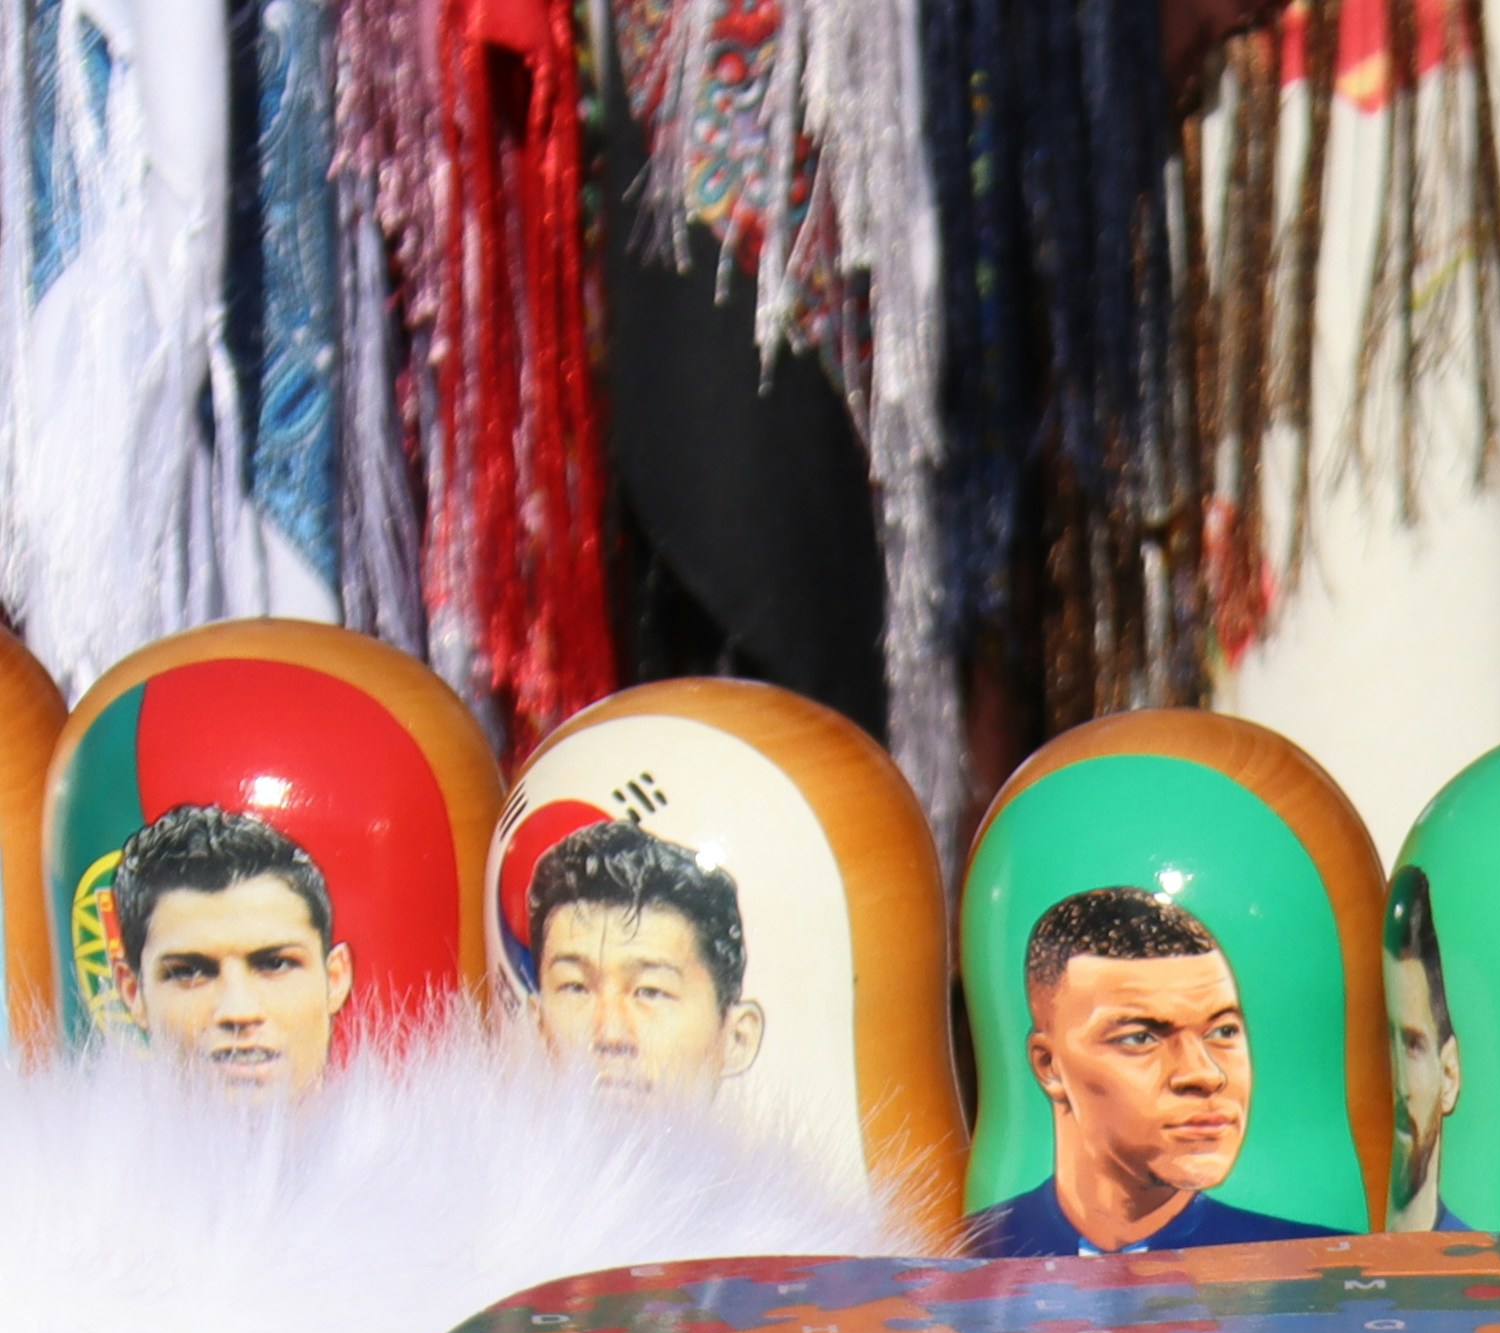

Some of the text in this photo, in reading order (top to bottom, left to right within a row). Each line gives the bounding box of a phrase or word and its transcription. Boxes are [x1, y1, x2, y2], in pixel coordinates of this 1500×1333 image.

[1326, 1241, 1351, 1252] J
[1343, 1279, 1387, 1291] M
[1363, 1318, 1406, 1331] Q
